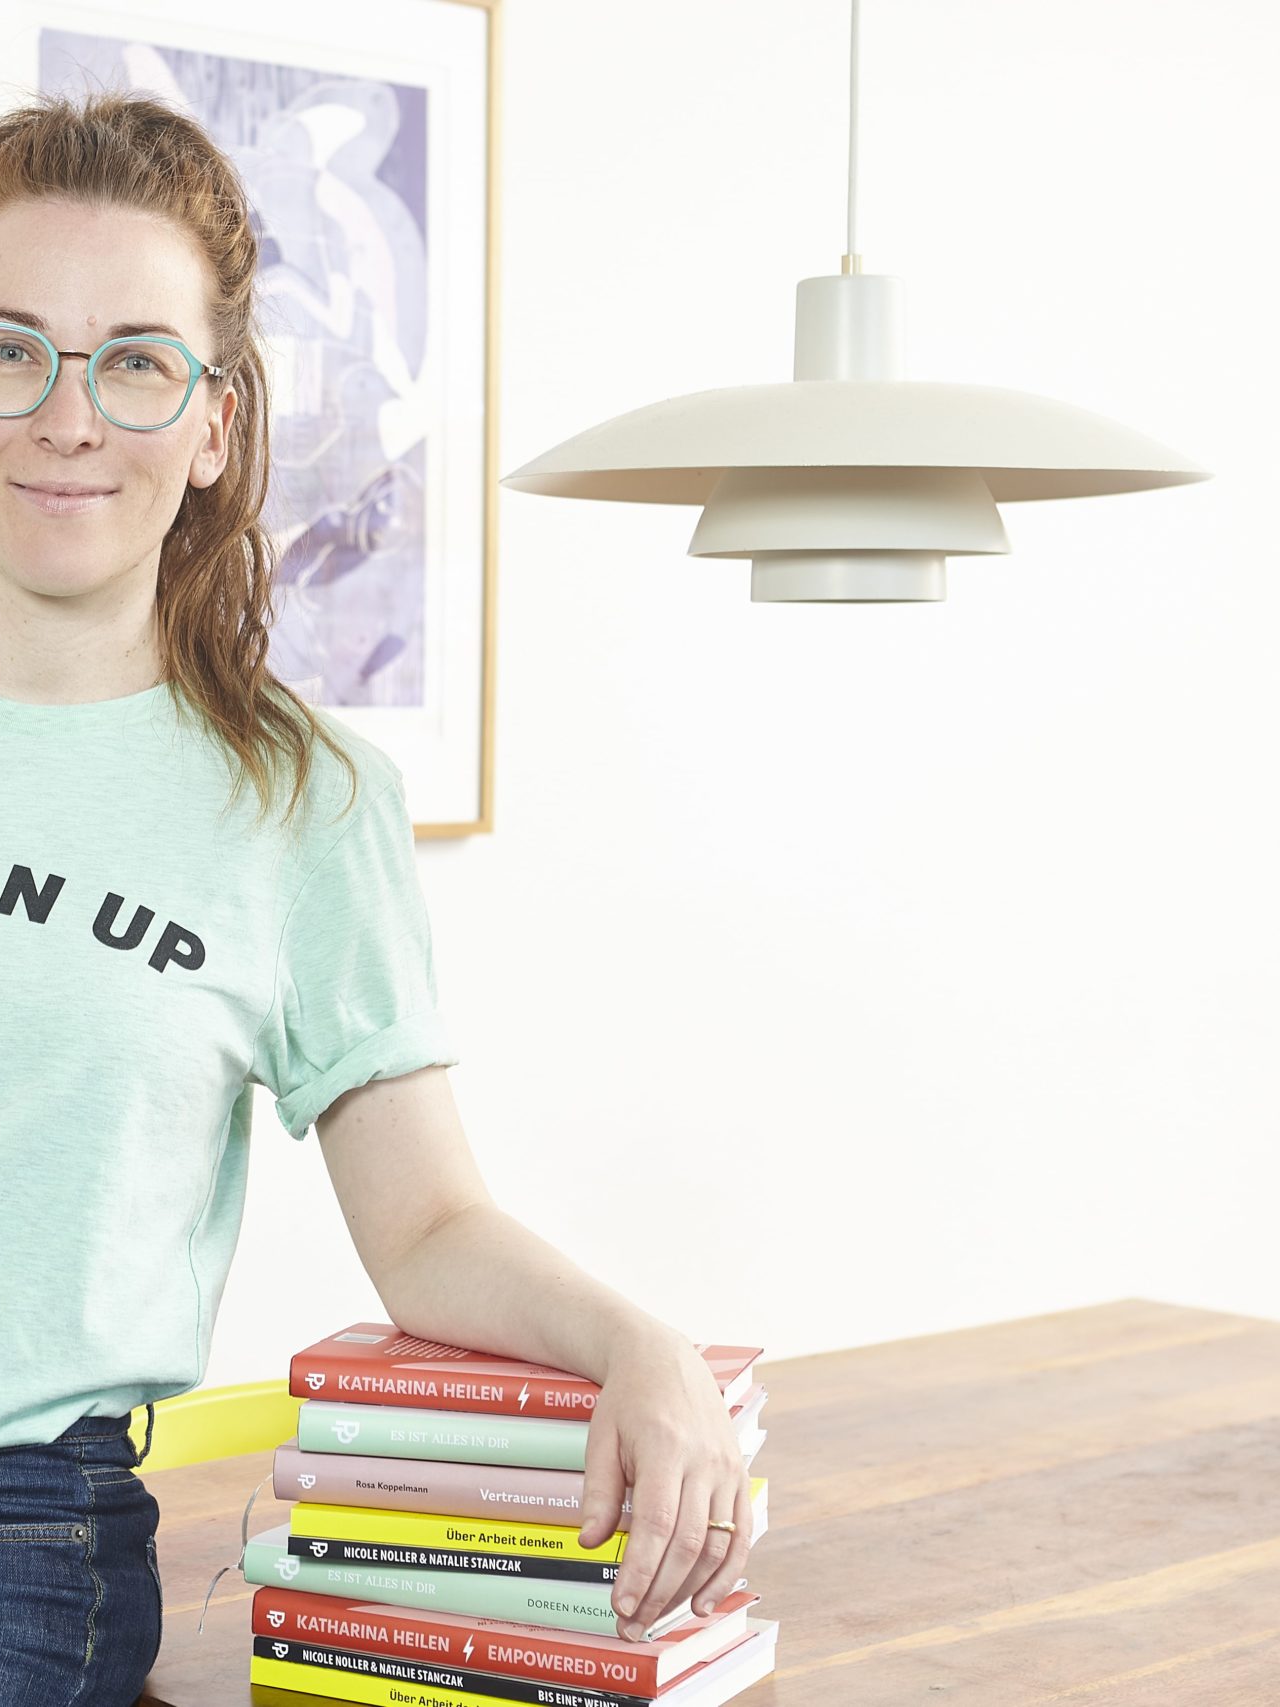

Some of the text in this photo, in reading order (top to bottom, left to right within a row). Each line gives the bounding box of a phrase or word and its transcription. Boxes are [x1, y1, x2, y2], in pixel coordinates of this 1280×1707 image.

[92, 892, 206, 974] UP
[338, 1375, 600, 1409] KATHARINA HEILEN EMPO
[390, 1430, 509, 1449] ES IST ALLES IN DIR
[356, 1480, 428, 1494] Rosa Koppelmann
[480, 1488, 579, 1508] Vertrauen nach
[446, 1528, 563, 1549] Über Arbeit denken
[343, 1546, 619, 1580] NICOLE NOLLER & NATALIE STANCZAK BIS
[327, 1570, 436, 1595] ES IST ALLES IN DIR
[527, 1599, 615, 1618] DOREEN KASCHA
[297, 1614, 638, 1683] KATHARINA HEILEN EMPOWERED YOU
[302, 1649, 333, 1665] NICOLE
[335, 1654, 369, 1671] NOLLER
[370, 1662, 377, 1672] &
[379, 1663, 415, 1680] NATALIE
[417, 1670, 463, 1688] STANCZAK
[538, 1690, 554, 1703] BIS
[390, 1688, 416, 1704] Über
[418, 1696, 453, 1707] Arbeit
